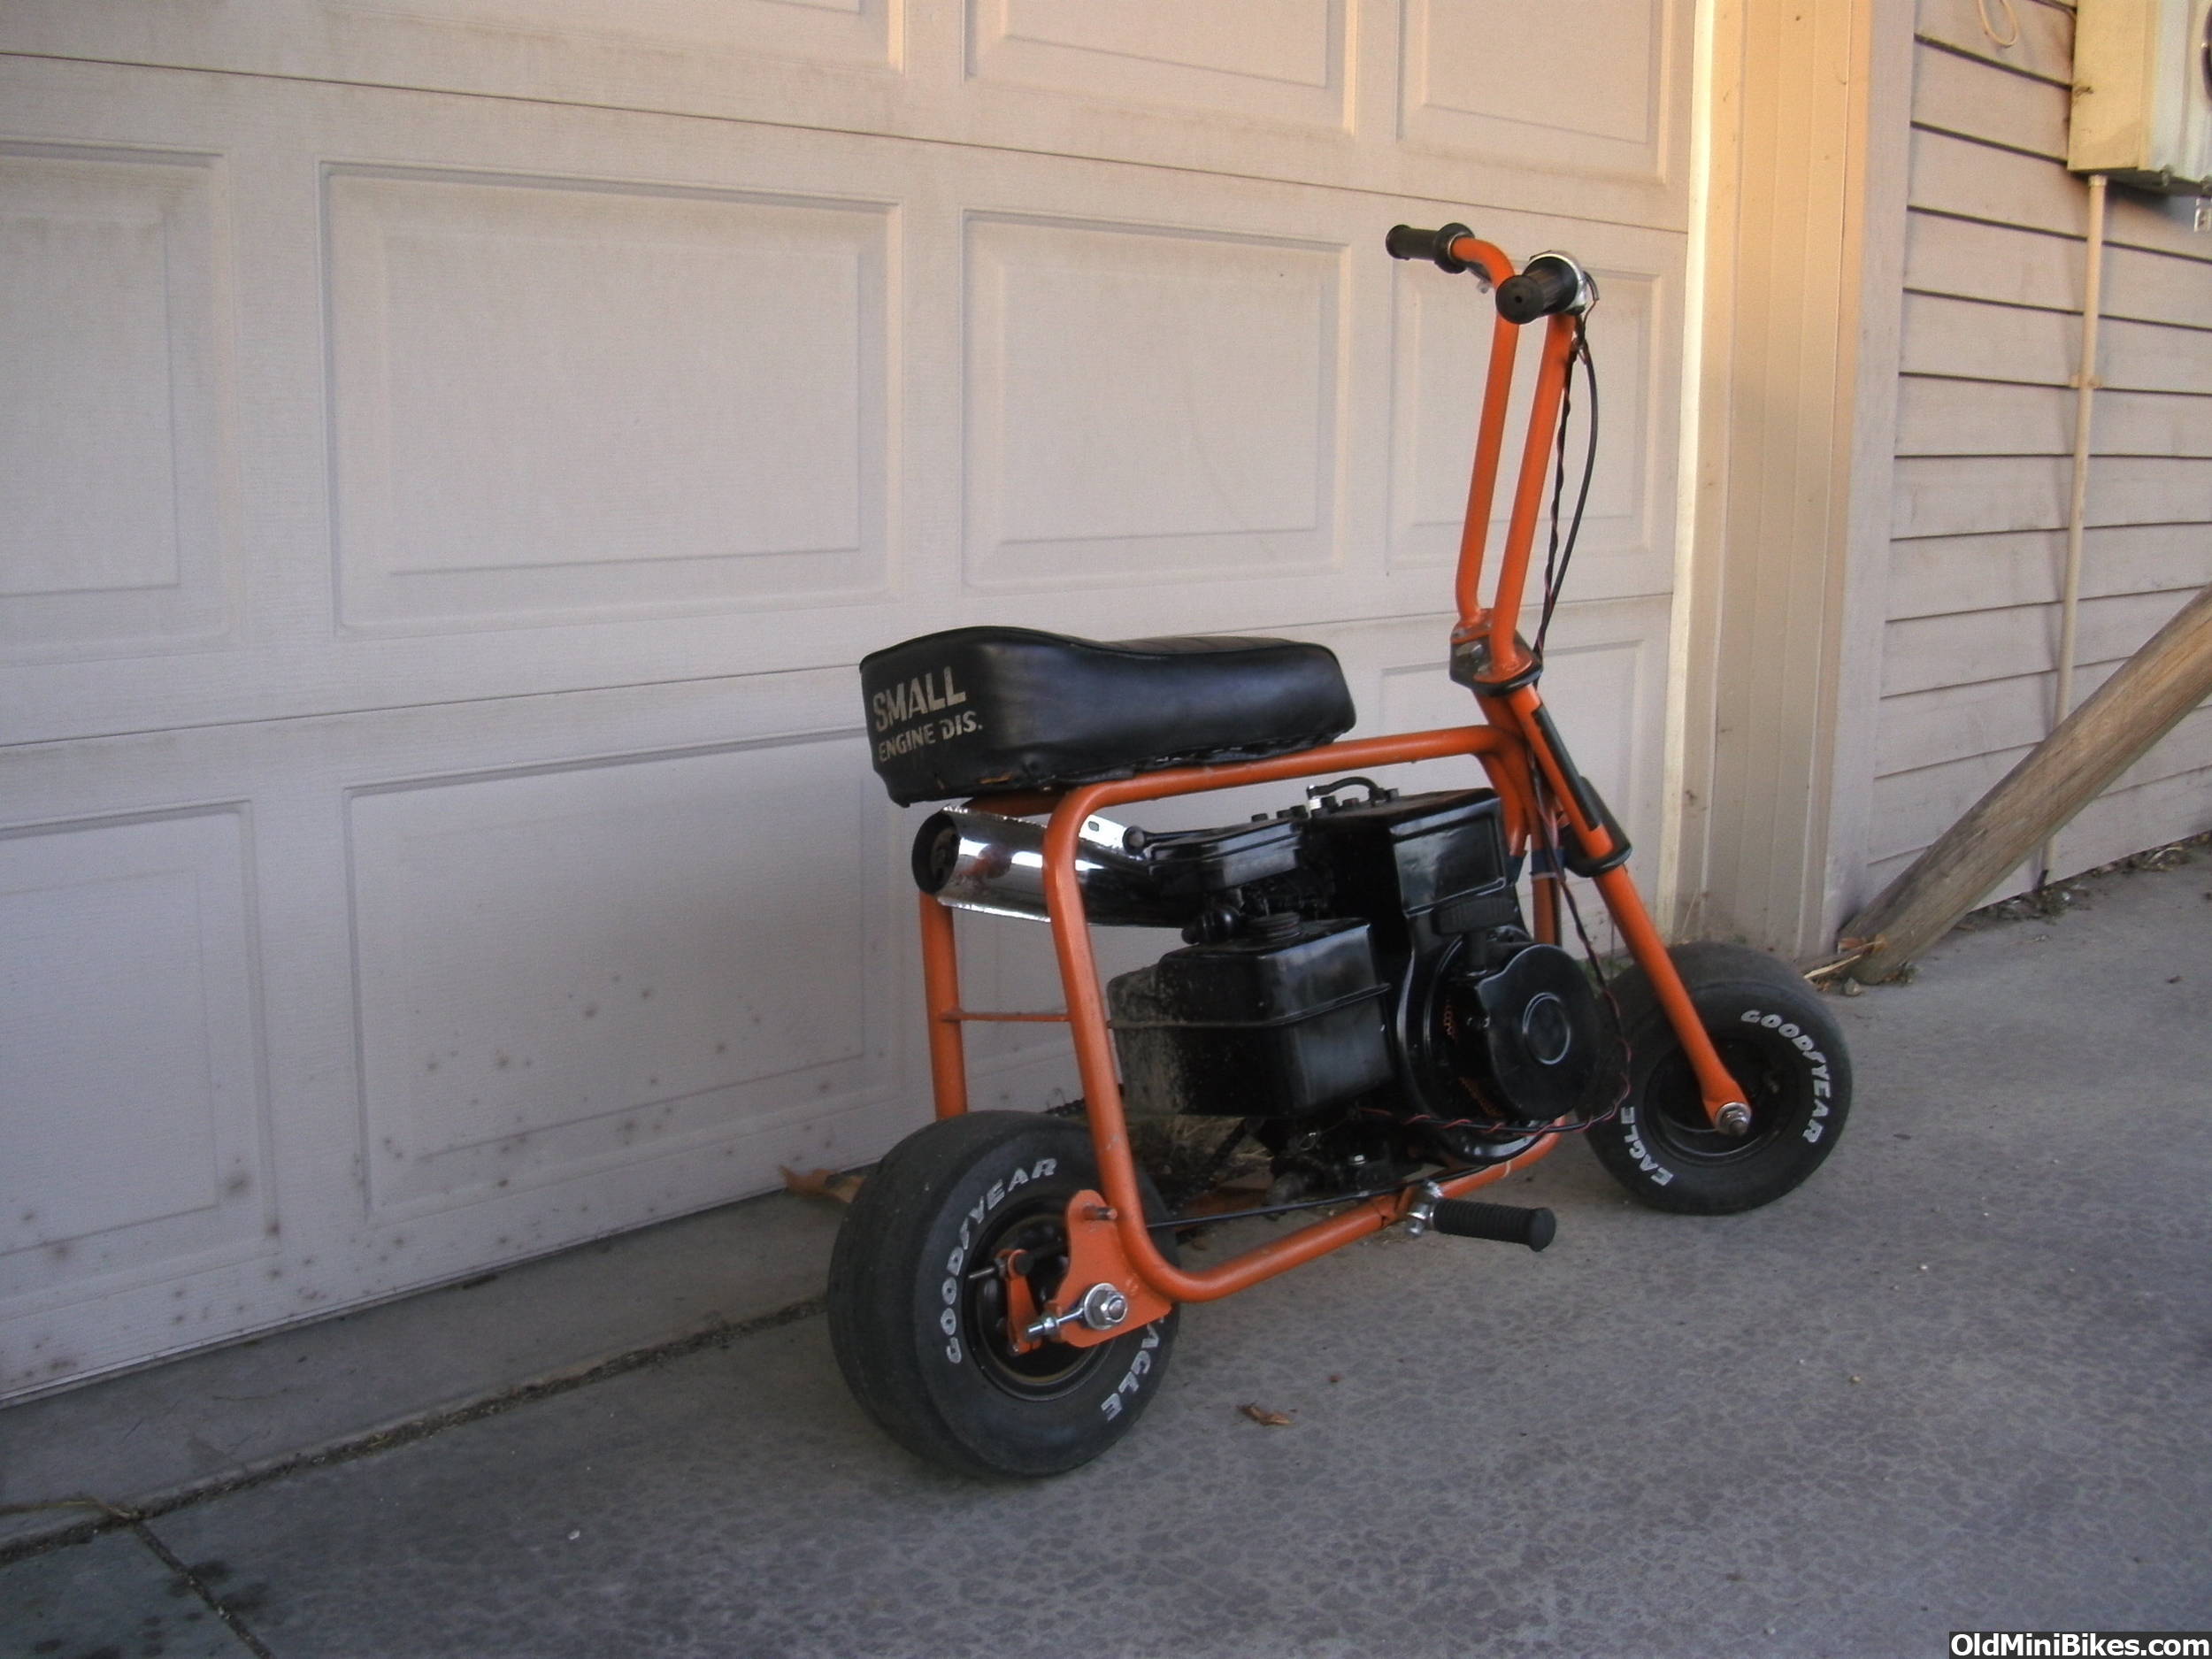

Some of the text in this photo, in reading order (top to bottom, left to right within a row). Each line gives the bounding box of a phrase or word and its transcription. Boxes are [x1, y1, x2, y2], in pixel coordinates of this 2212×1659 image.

[872, 665, 966, 733] SMALL
[879, 723, 936, 763] ENGINE
[1740, 1010, 1831, 1143] GOODYEAR
[1620, 1106, 1674, 1187] EAGLE
[940, 1157, 1057, 1364] GOODYEAR
[1101, 1317, 1164, 1421] AGLE
